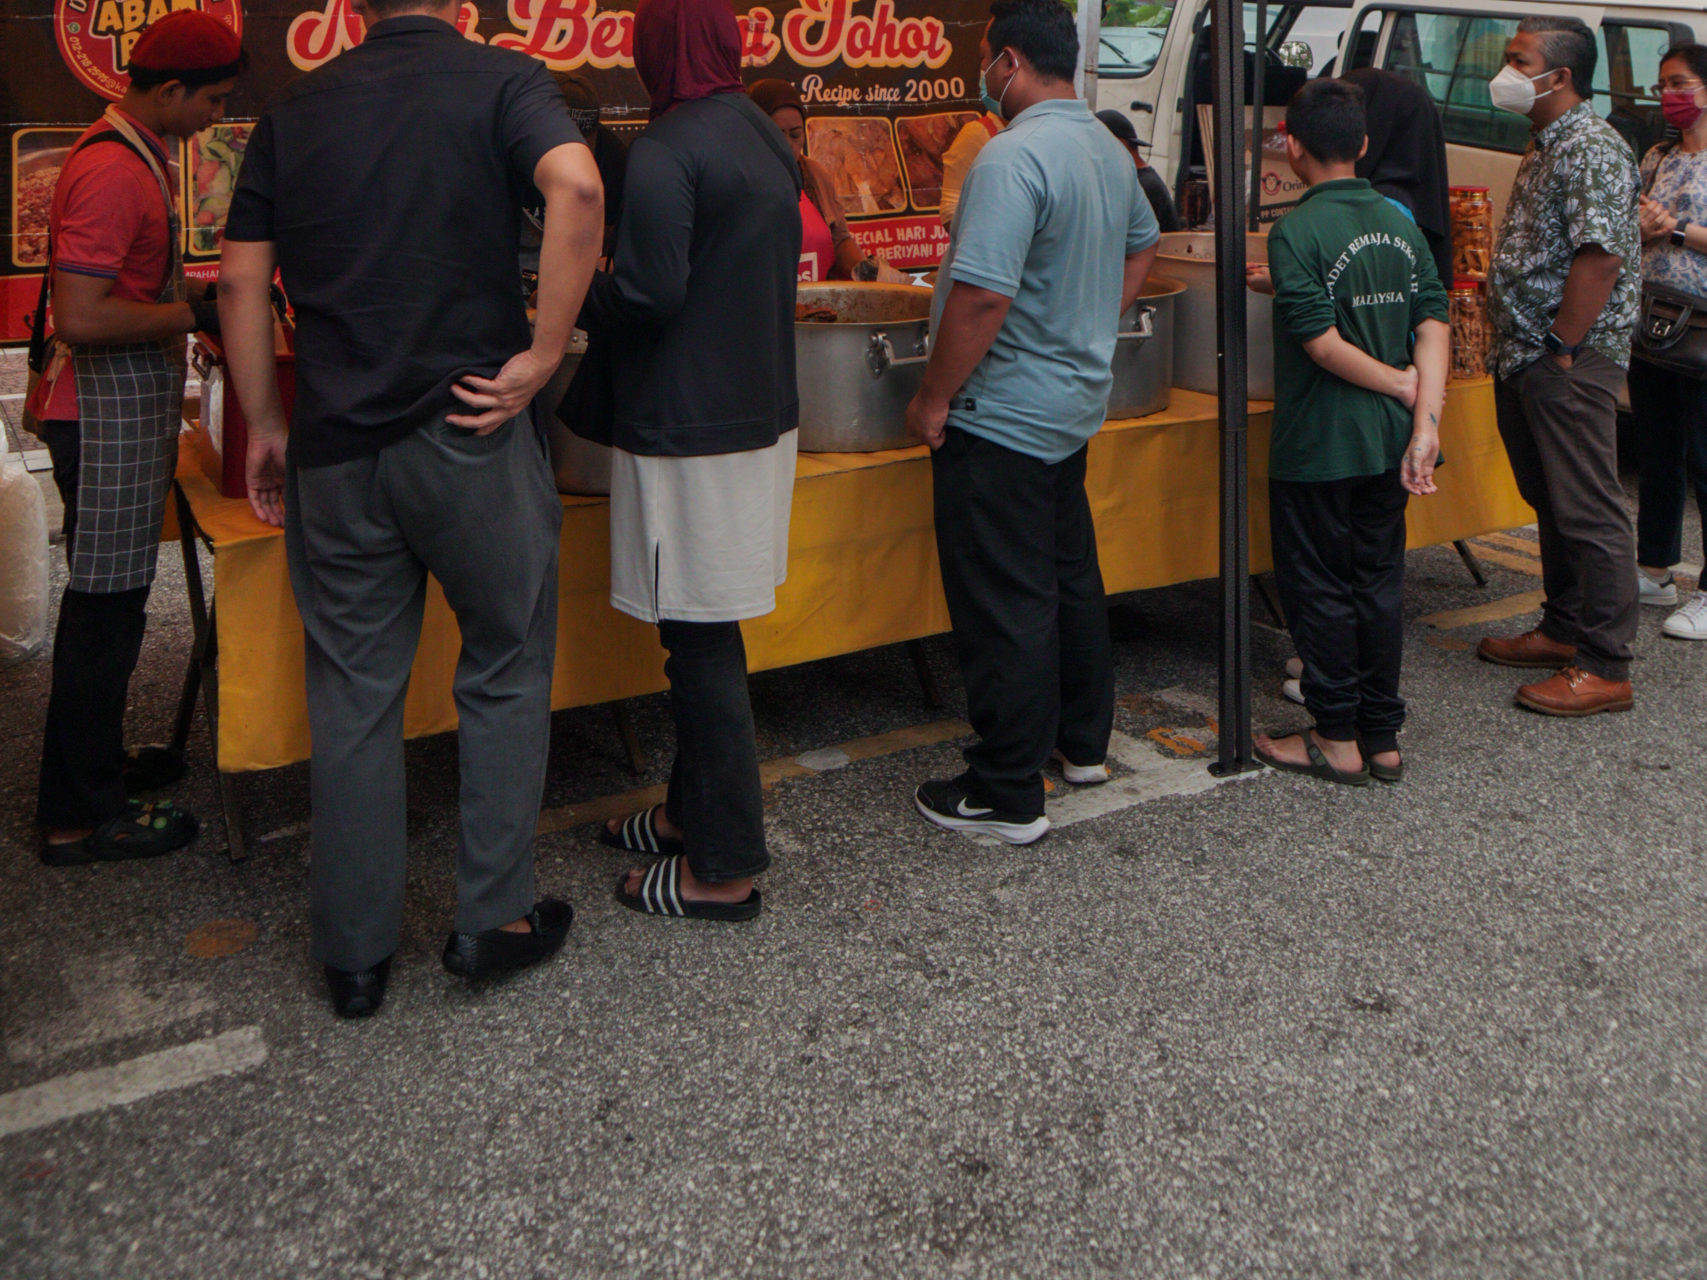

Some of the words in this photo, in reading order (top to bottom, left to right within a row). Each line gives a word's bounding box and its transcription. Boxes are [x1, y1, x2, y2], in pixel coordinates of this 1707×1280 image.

[801, 74, 862, 107] Recipe
[865, 83, 901, 102] since
[904, 76, 965, 103] 2000
[896, 226, 926, 241] HARI
[1348, 232, 1391, 255] REMAJA
[1352, 291, 1405, 307] MALAYSIA
